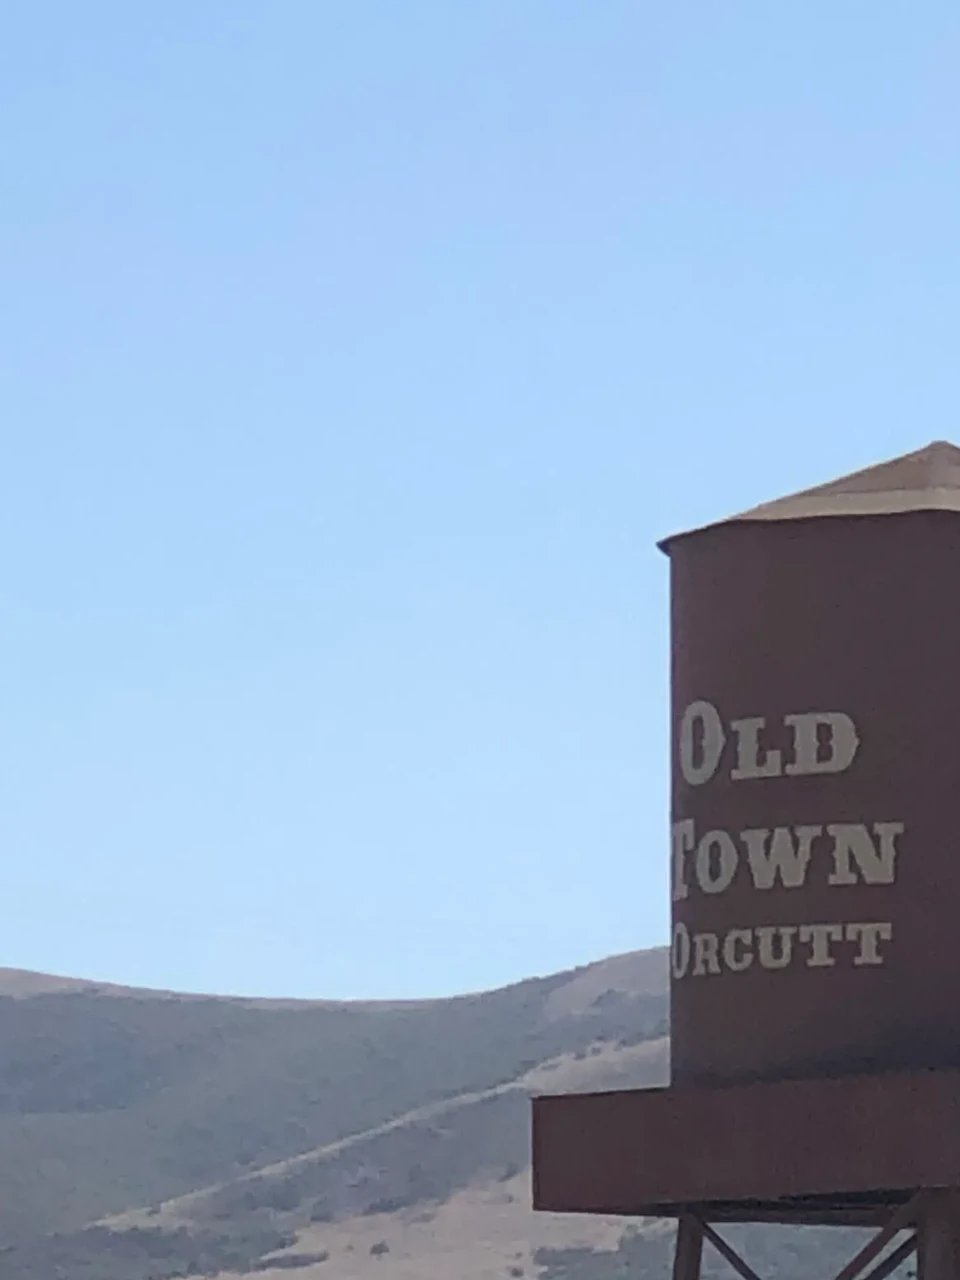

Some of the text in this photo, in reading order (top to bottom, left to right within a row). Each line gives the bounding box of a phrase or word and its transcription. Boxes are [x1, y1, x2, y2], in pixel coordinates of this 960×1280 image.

[680, 700, 860, 786] OLD
[672, 818, 905, 902] TOWN
[672, 922, 892, 980] ORCUTT
